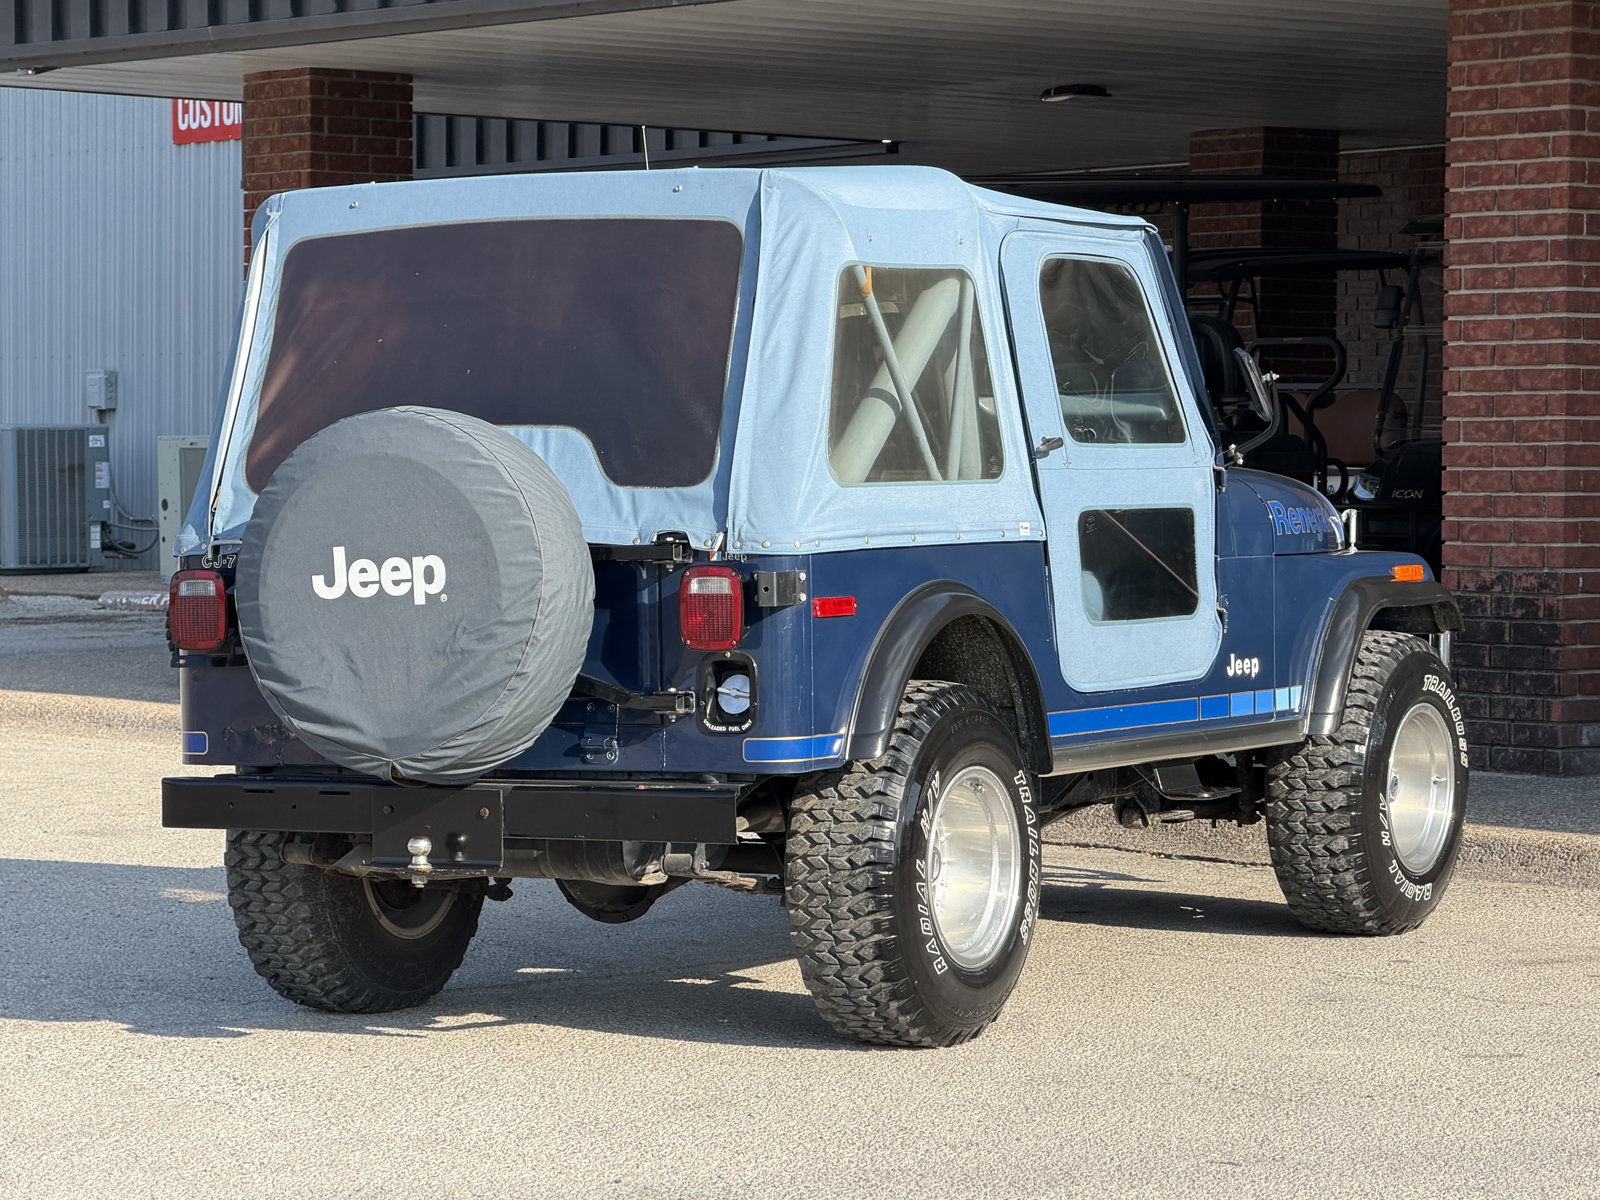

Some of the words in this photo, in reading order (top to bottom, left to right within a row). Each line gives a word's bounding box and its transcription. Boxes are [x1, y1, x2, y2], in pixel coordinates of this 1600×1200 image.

[1391, 489, 1424, 499] ICON
[722, 551, 748, 564] Jeep
[311, 545, 447, 606] Jeep
[1226, 653, 1260, 679] Jeep
[703, 718, 727, 732] UNLEADED
[741, 718, 753, 731] ONLY
[1388, 858, 1433, 902] RADIAL
[916, 858, 948, 975] RADIAL
